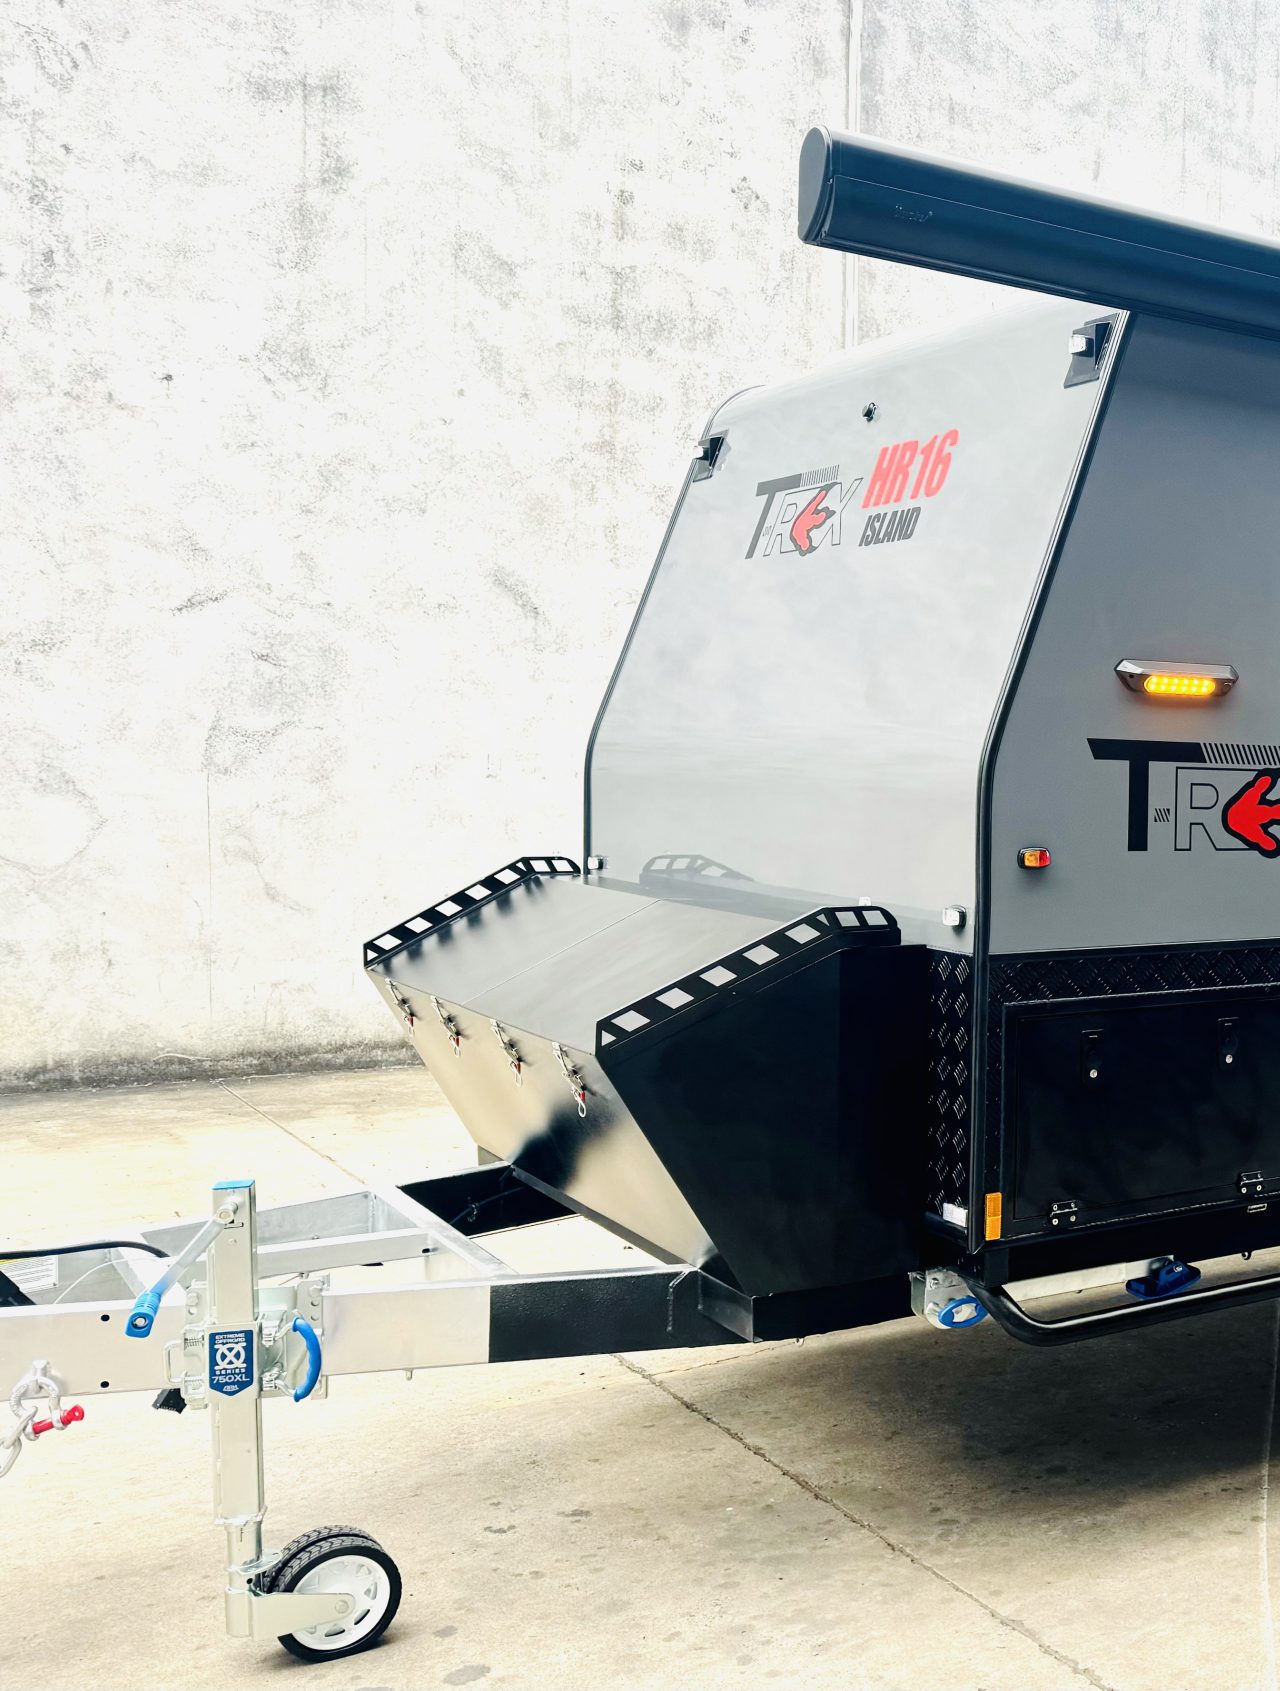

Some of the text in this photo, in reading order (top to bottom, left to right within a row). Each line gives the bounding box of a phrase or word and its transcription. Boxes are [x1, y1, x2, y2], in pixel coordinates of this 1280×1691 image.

[862, 428, 960, 509] HR16
[858, 506, 921, 547] ISLAND
[211, 1374, 250, 1384] 750XL
